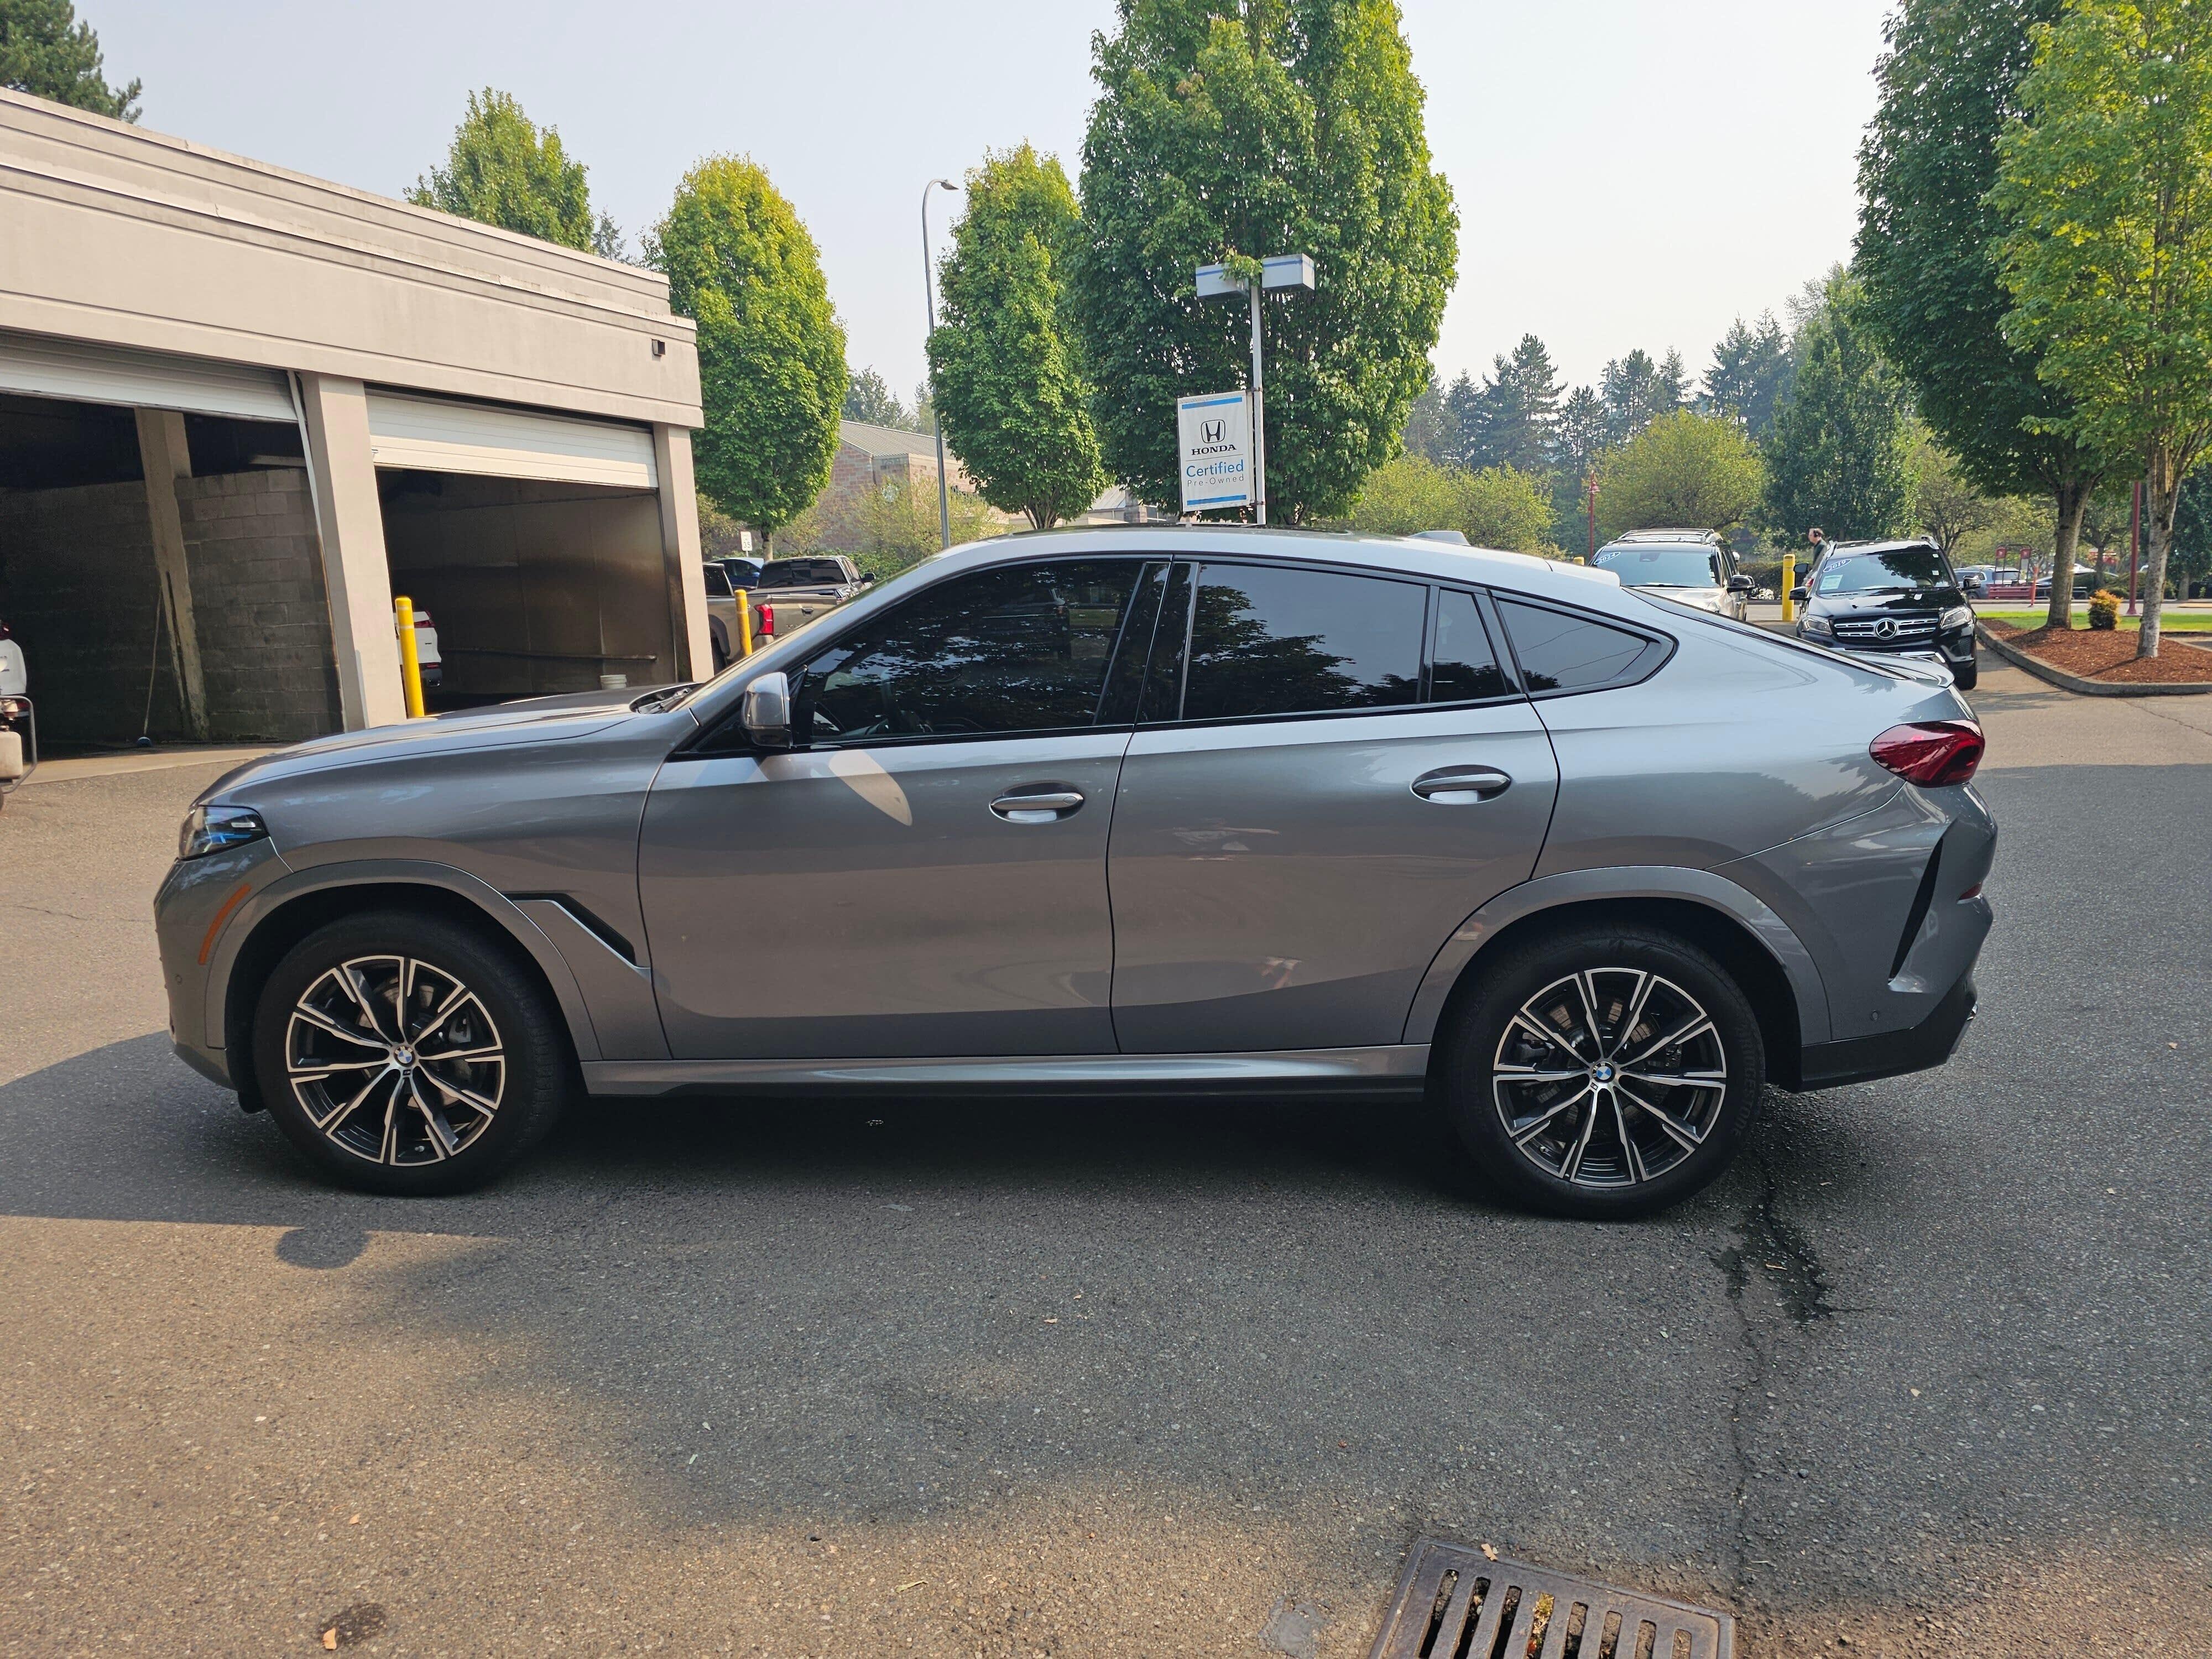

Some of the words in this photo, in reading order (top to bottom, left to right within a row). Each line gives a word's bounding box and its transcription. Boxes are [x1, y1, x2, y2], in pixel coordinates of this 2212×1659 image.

[1191, 445, 1237, 455] HONDA
[1187, 459, 1244, 477] Certified
[1187, 473, 1244, 487] Pre-Owned
[1829, 560, 1846, 570] 2019
